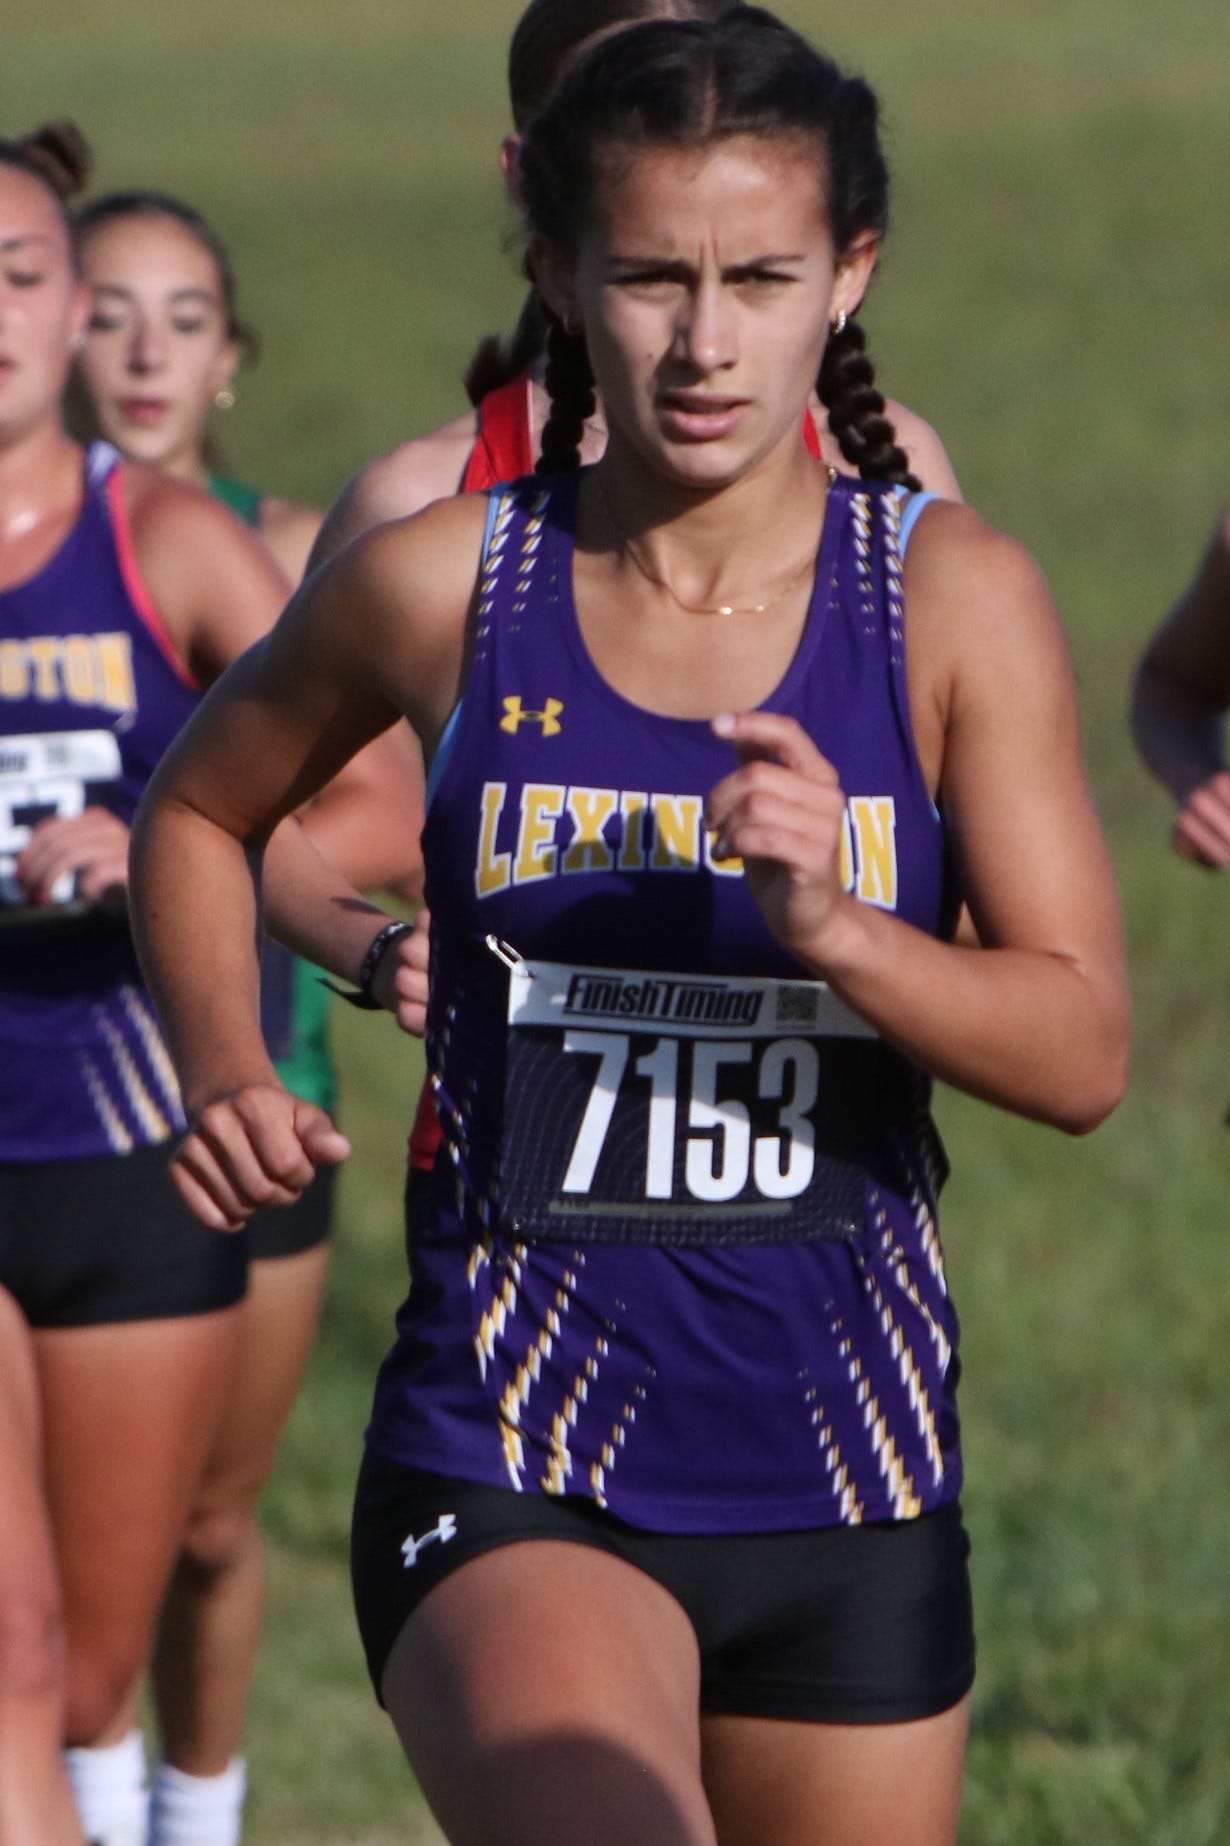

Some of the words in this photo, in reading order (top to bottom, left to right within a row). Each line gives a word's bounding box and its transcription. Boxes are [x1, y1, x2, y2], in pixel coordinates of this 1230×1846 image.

[475, 781, 898, 911] LEXINN
[563, 972, 766, 1027] FinishTiming
[562, 1029, 820, 1202] 7153
